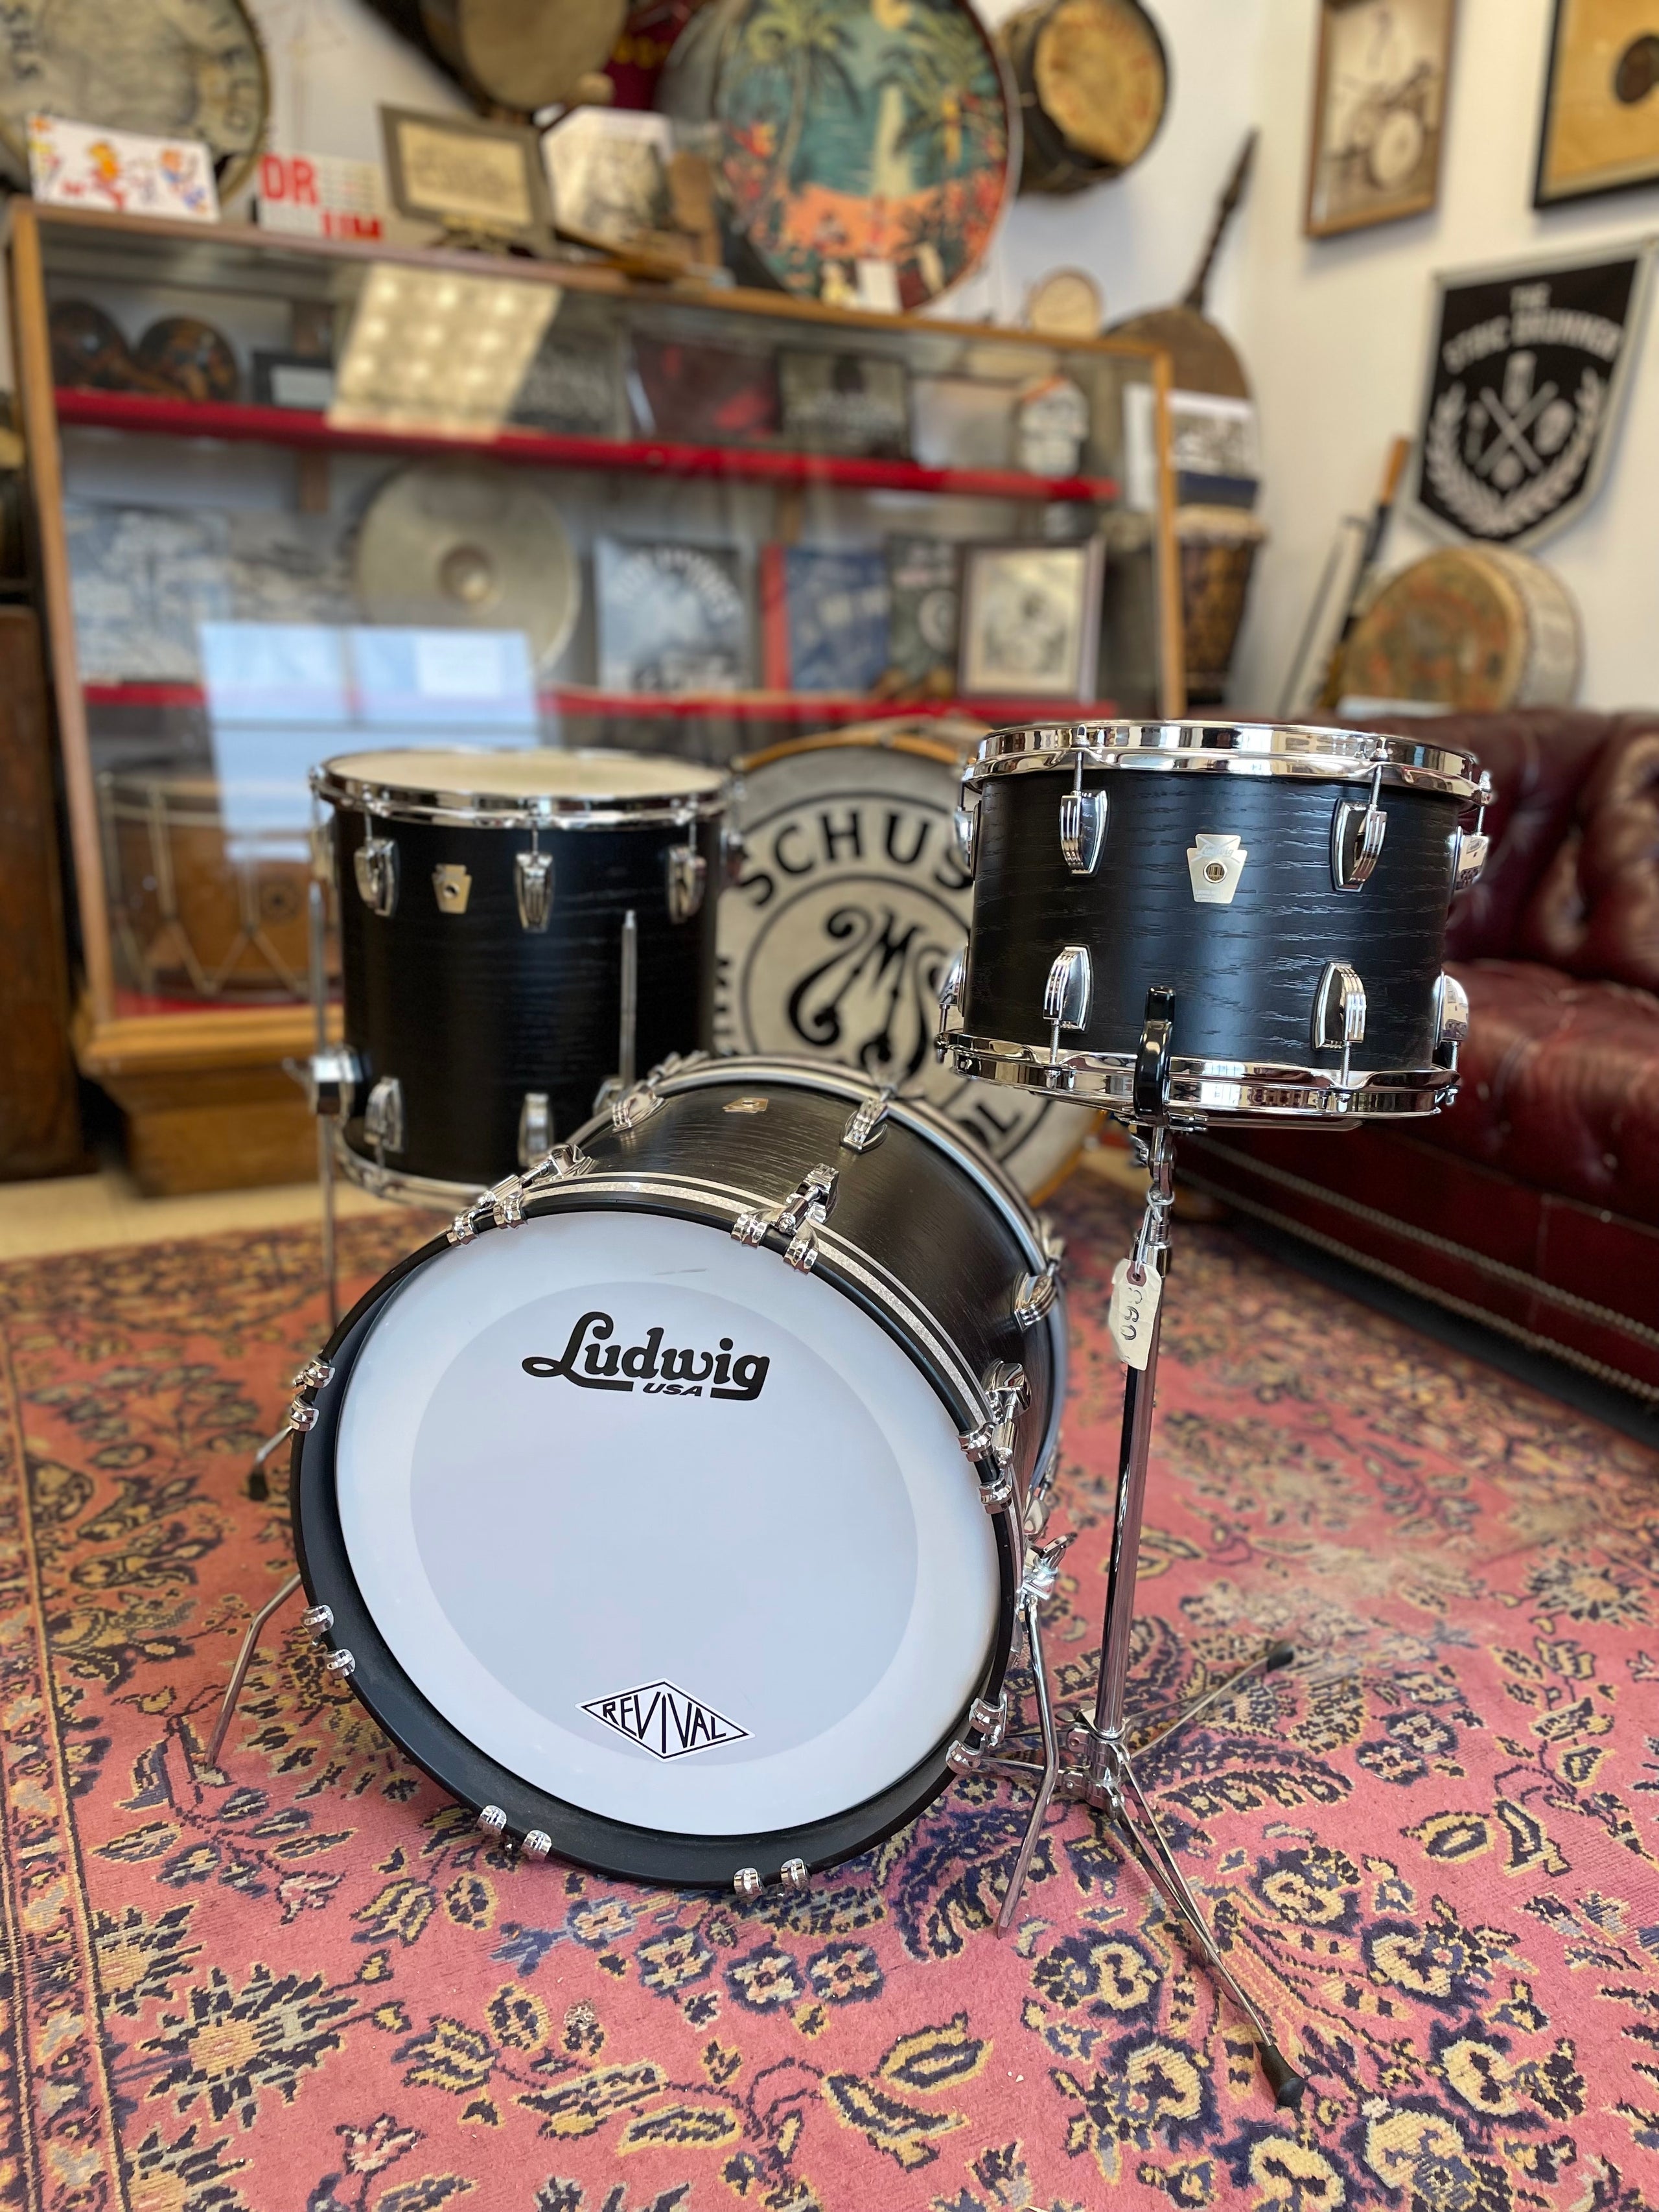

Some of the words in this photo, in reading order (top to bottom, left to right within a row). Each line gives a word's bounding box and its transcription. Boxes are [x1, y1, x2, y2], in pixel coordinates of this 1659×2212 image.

[522, 1311, 770, 1401] Ludwig
[642, 1382, 702, 1397] USA
[603, 1691, 726, 1754] REVIVAL
